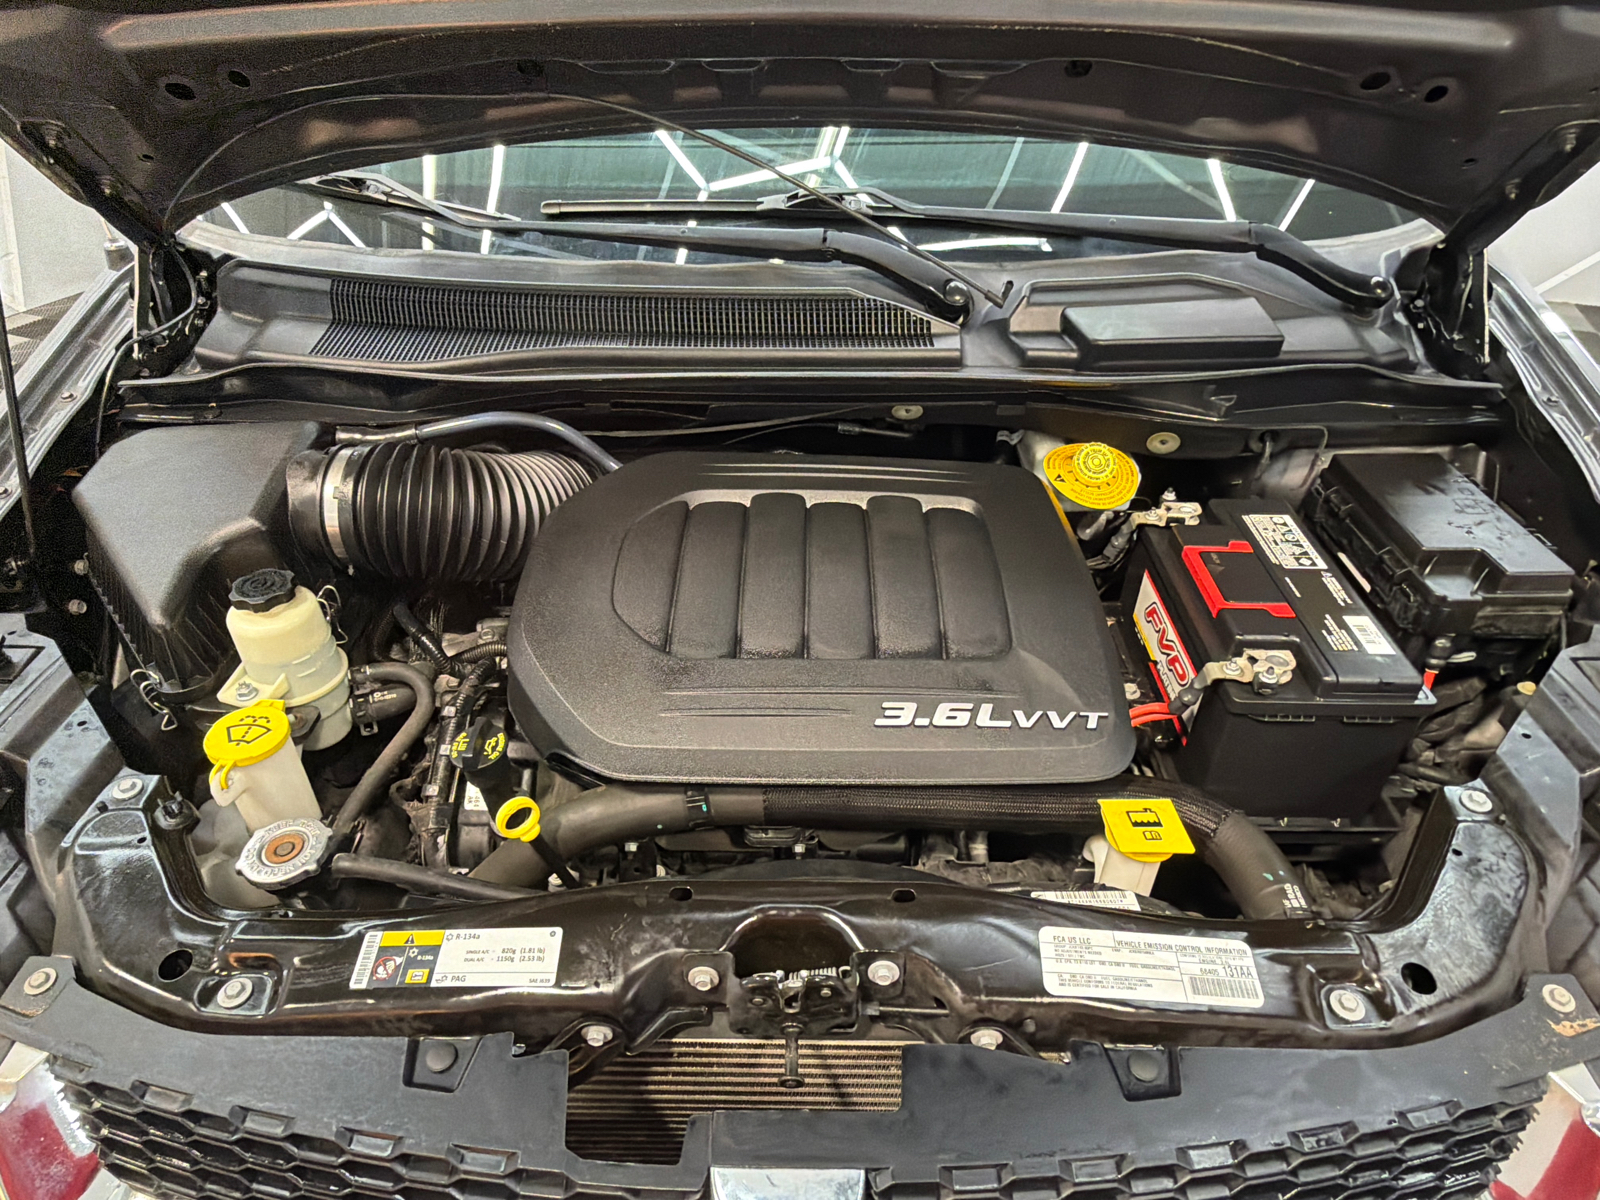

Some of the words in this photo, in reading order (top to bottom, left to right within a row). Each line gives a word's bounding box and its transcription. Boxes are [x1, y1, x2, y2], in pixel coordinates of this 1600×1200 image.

[1144, 601, 1190, 687] FVP
[1012, 709, 1109, 730] VVT
[455, 933, 481, 941] R-134a
[1052, 935, 1066, 943] FCA
[1078, 937, 1092, 945] LLC
[501, 947, 517, 955] 820g
[520, 947, 536, 955] (1.81
[536, 947, 546, 955] lb)
[1115, 939, 1142, 949] VEHICLE
[1143, 942, 1174, 951] EMISSION
[1174, 944, 1203, 953] CONTROL
[1204, 946, 1248, 956] INFORMATION
[496, 955, 515, 963] 1150g
[519, 955, 535, 963] (2.53
[536, 955, 545, 963] lb)
[1222, 965, 1254, 979] 131AA
[450, 975, 467, 983] PAG
